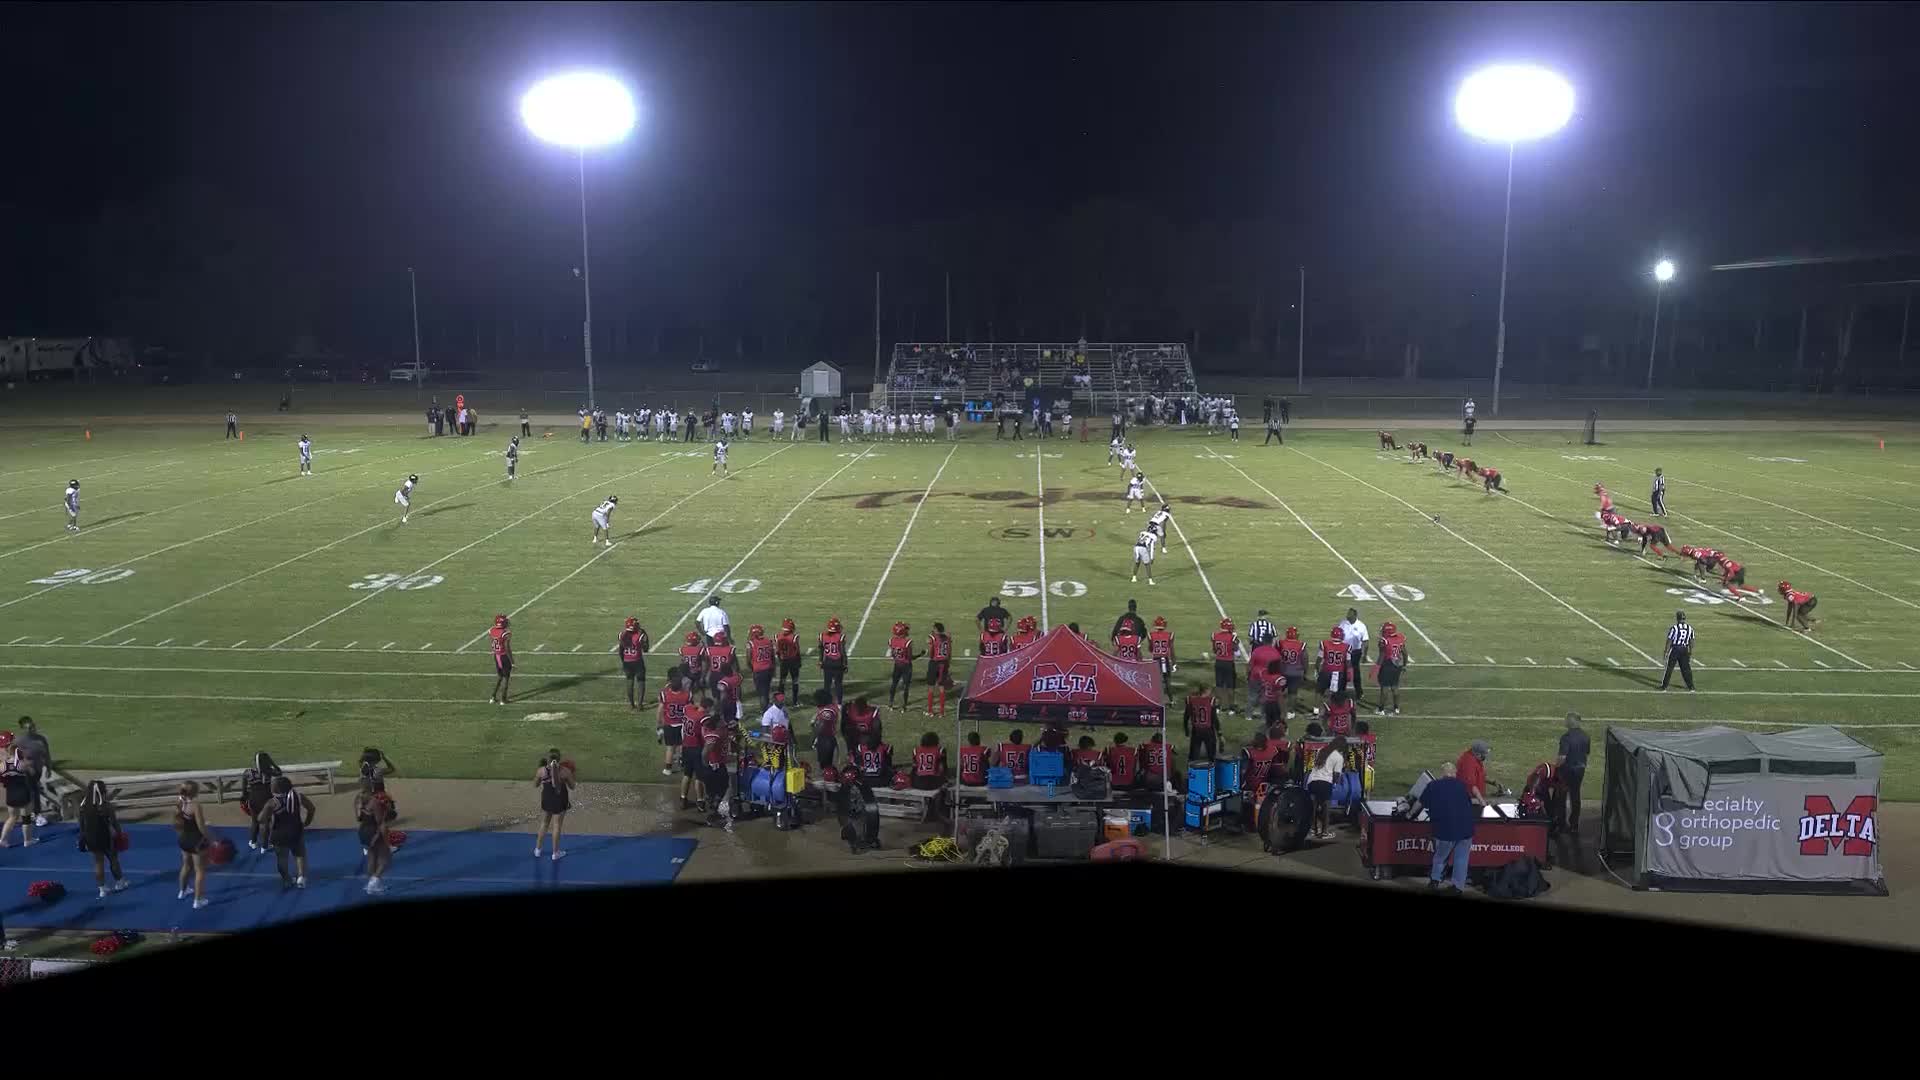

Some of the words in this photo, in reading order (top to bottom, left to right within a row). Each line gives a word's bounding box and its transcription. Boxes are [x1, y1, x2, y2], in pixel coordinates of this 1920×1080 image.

[30, 568, 136, 584] 20
[348, 573, 444, 591] 30
[669, 578, 761, 594] 40
[999, 580, 1088, 597] 50
[1336, 584, 1425, 601] 40
[1031, 674, 1098, 693] DELTA
[919, 753, 936, 772] 19
[962, 754, 980, 774] 16
[1005, 751, 1025, 769] 54
[1692, 796, 1764, 816] ecialty
[1681, 813, 1781, 833] orthopedic
[1798, 813, 1876, 844] DELTA
[1396, 838, 1435, 853] DELTA
[1470, 844, 1489, 852] NITY
[1490, 844, 1525, 853] COLLEGE
[1680, 835, 1733, 850] group
